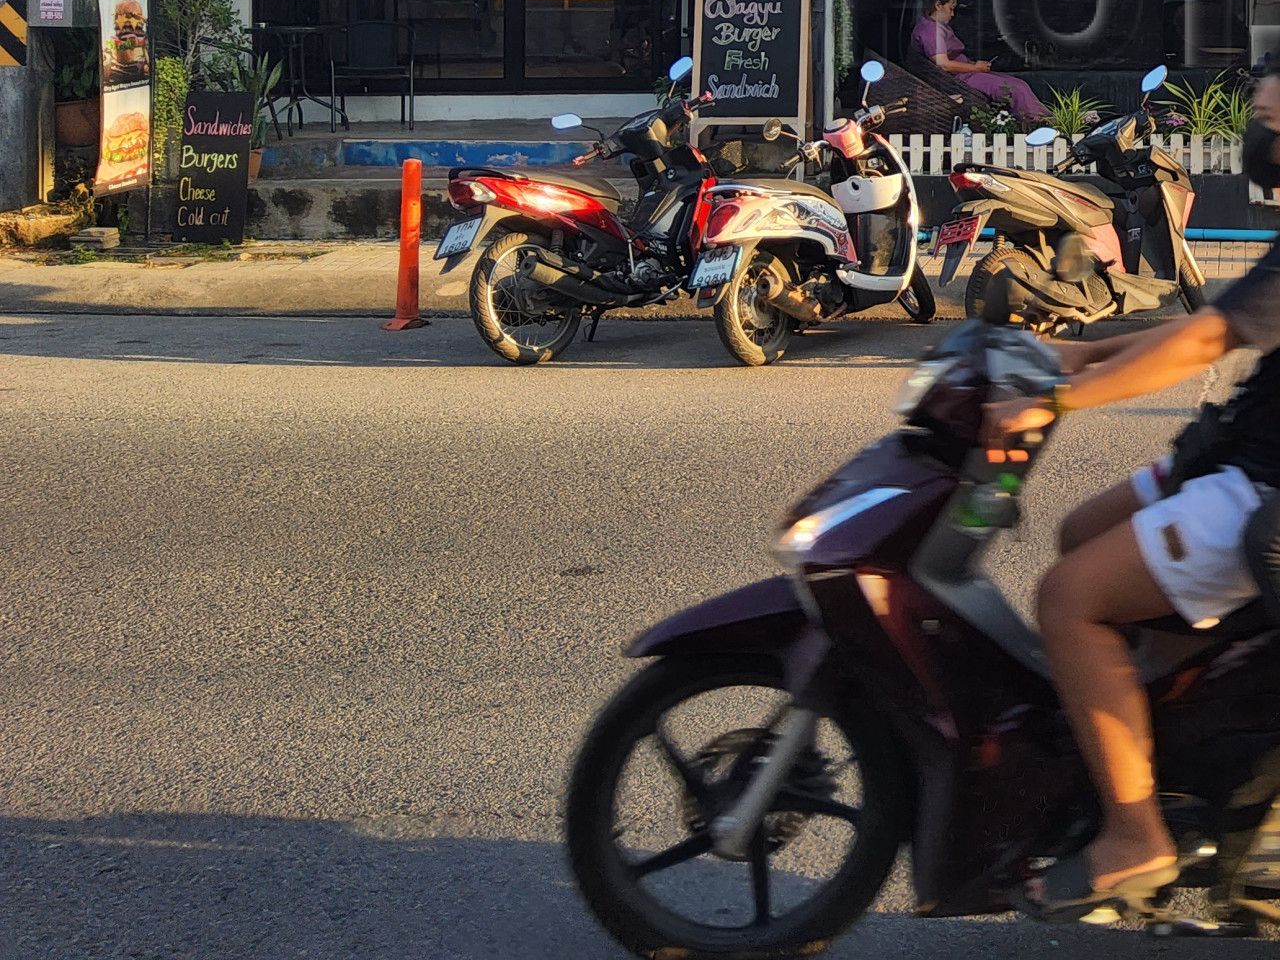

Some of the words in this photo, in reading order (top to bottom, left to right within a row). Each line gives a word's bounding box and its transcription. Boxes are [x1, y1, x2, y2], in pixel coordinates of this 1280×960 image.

[712, 23, 781, 51] Burger
[724, 50, 770, 71] Fresh
[707, 73, 780, 101] Sandwich
[183, 105, 252, 137] Sandwiches
[180, 145, 239, 170] Burgers
[180, 176, 216, 203] Cheese
[177, 206, 204, 227] Cold
[209, 208, 229, 227] cut
